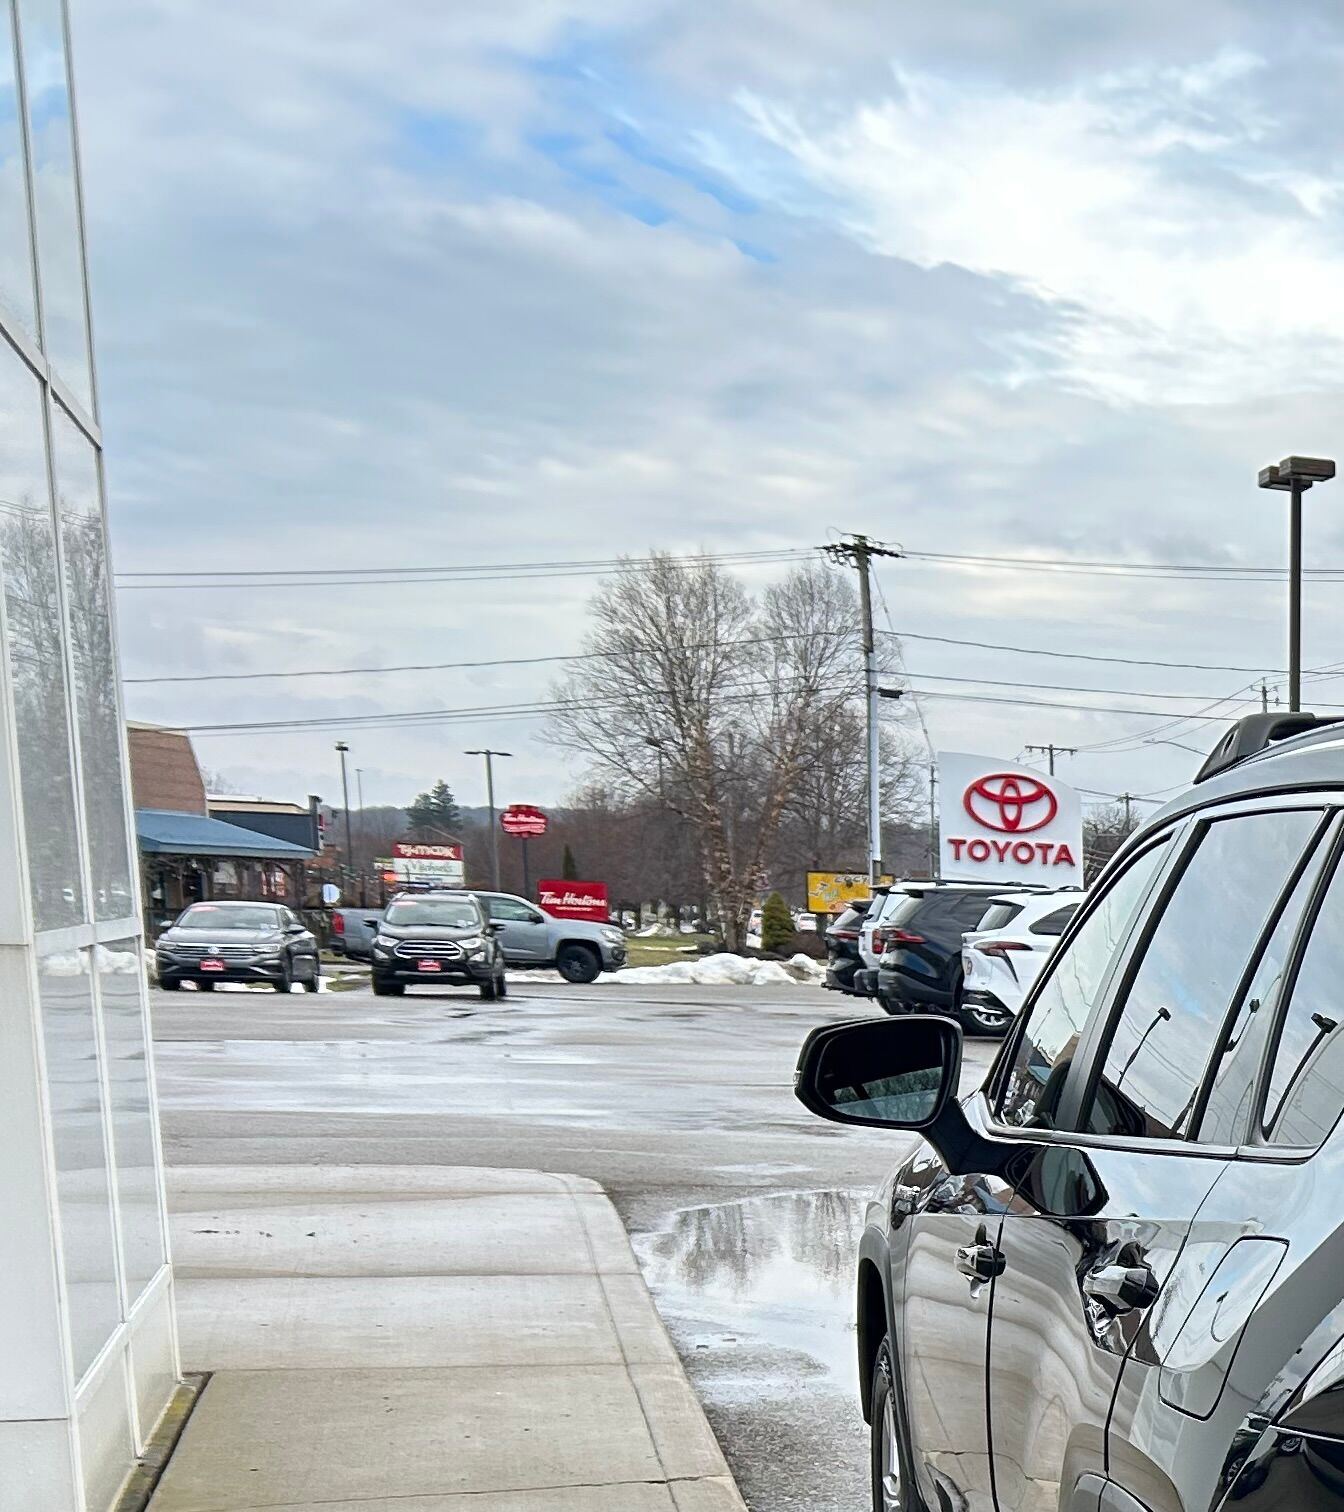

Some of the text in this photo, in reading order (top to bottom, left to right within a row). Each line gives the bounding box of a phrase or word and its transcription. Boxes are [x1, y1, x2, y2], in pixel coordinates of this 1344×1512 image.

[947, 838, 1076, 867] TOYOTA
[539, 892, 608, 907] Tim Hortons
